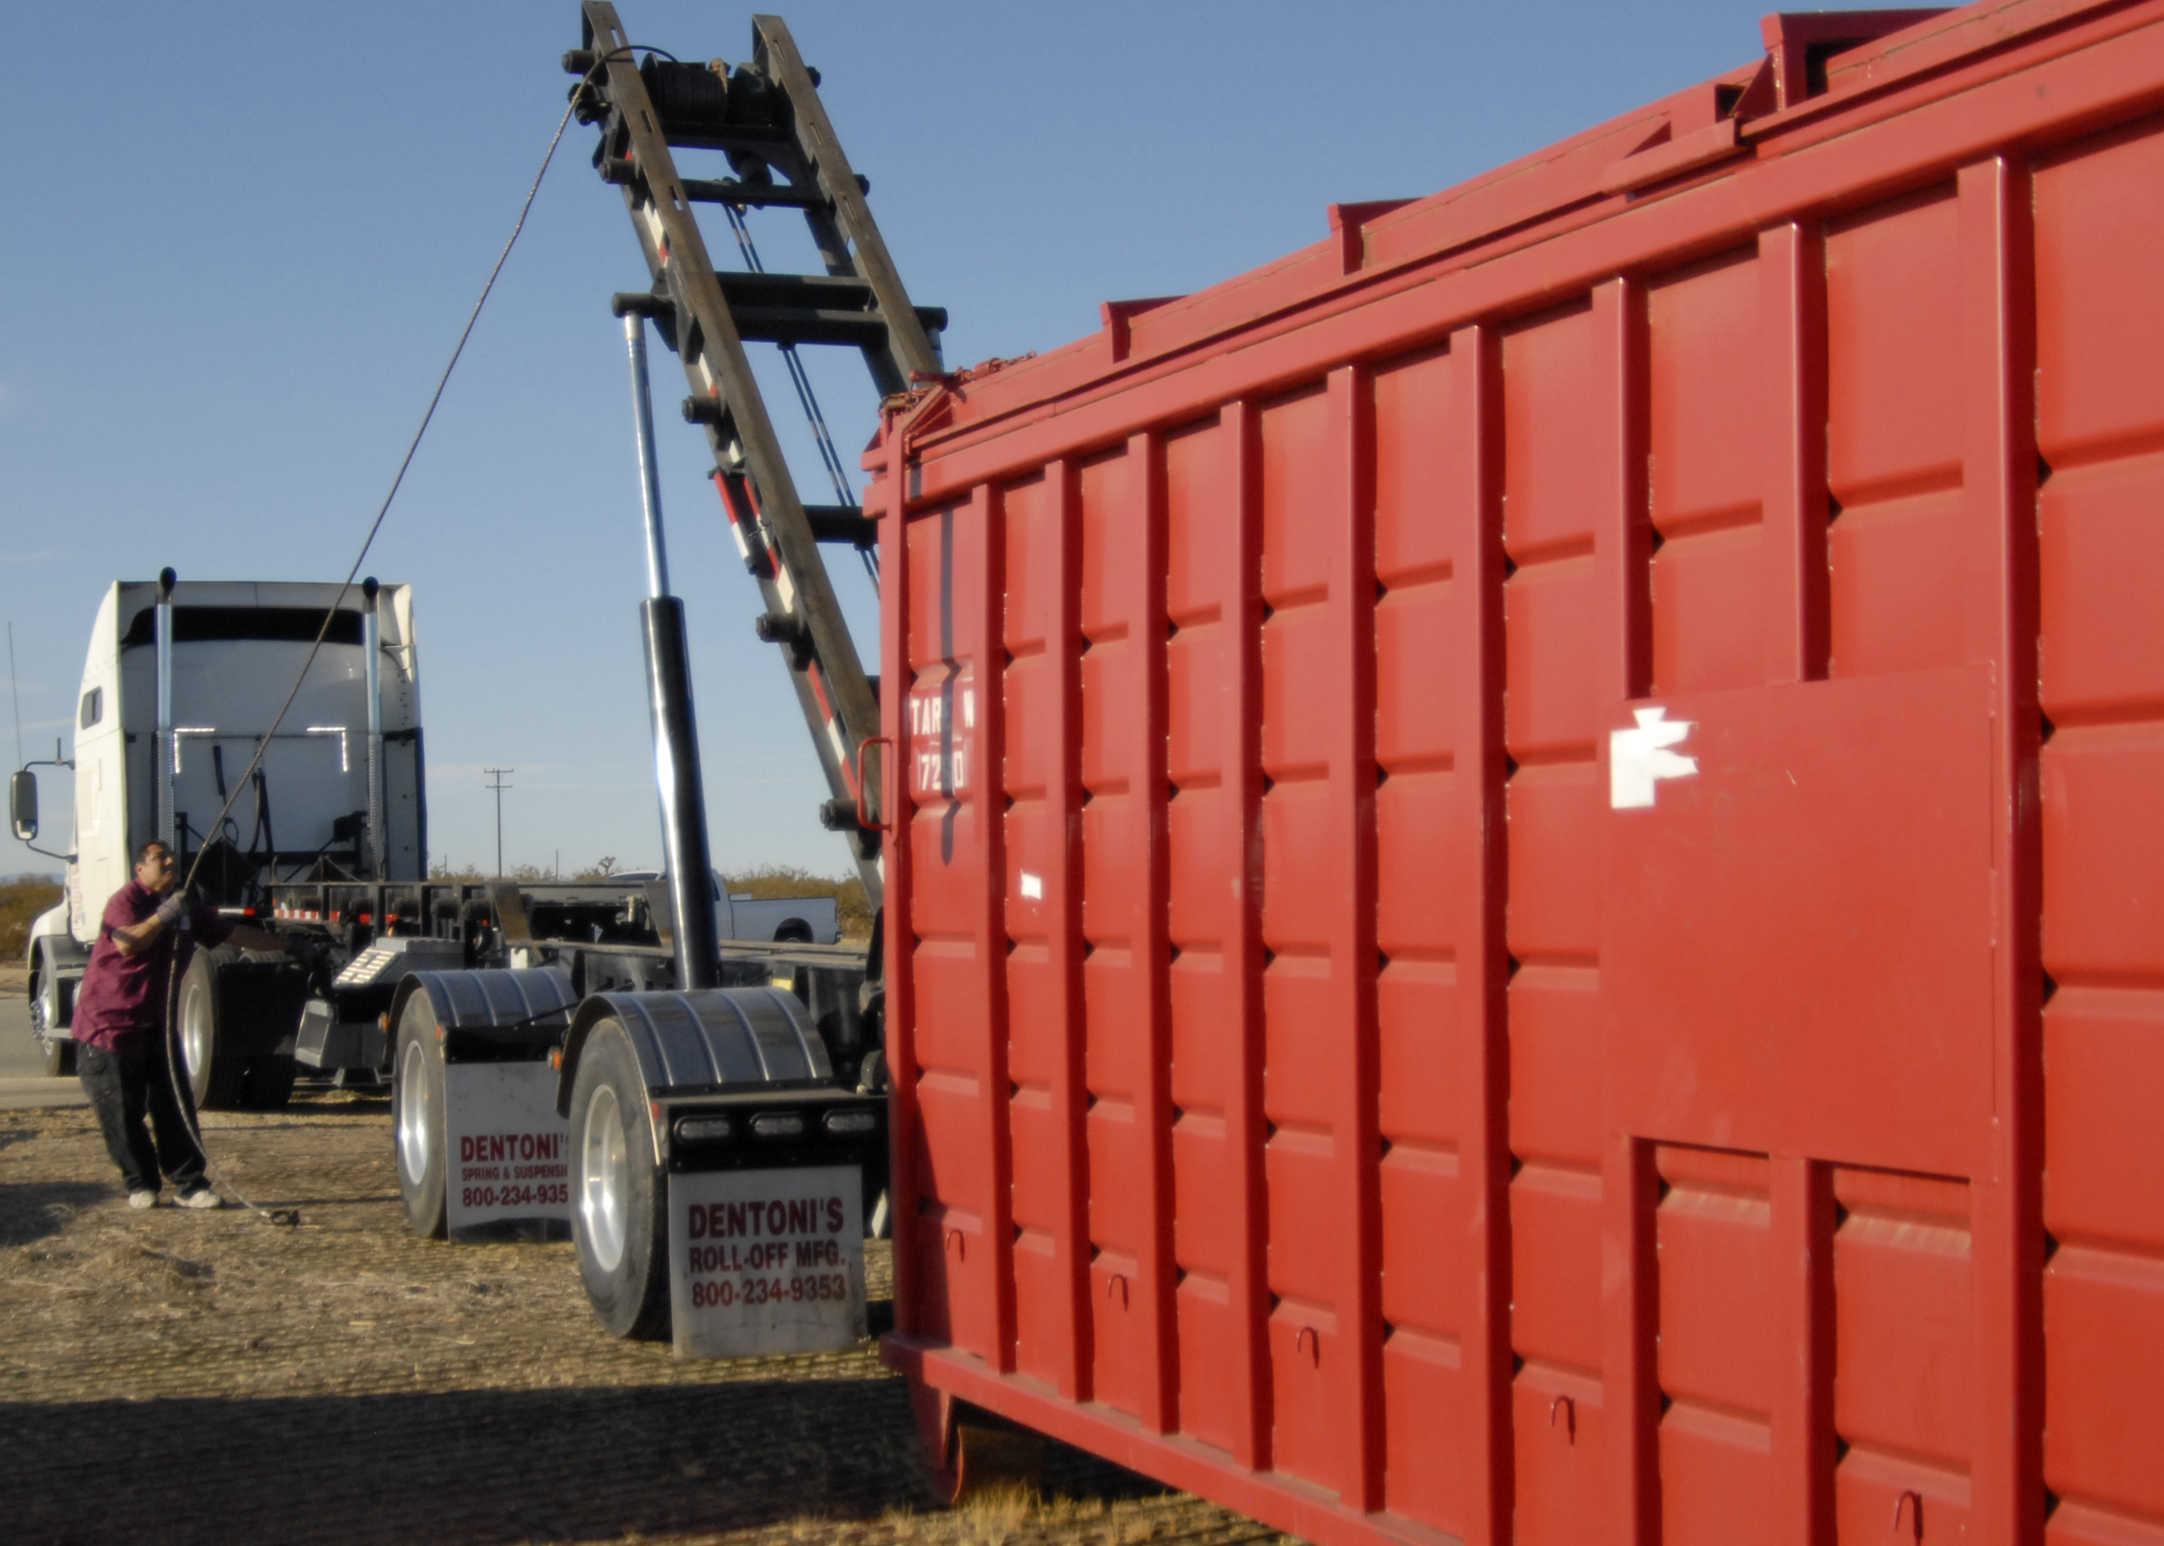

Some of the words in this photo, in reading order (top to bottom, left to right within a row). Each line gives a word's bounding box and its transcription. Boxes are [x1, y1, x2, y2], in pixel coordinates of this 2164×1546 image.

[461, 1133, 568, 1162] DENTONI'
[462, 1167, 500, 1181] SPRING
[503, 1166, 510, 1180] &
[689, 1197, 844, 1239] DENTONI'S
[689, 1242, 788, 1273] ROLL-OFF
[796, 1239, 845, 1268] MFG.
[692, 1274, 846, 1308] 800-234-9353
